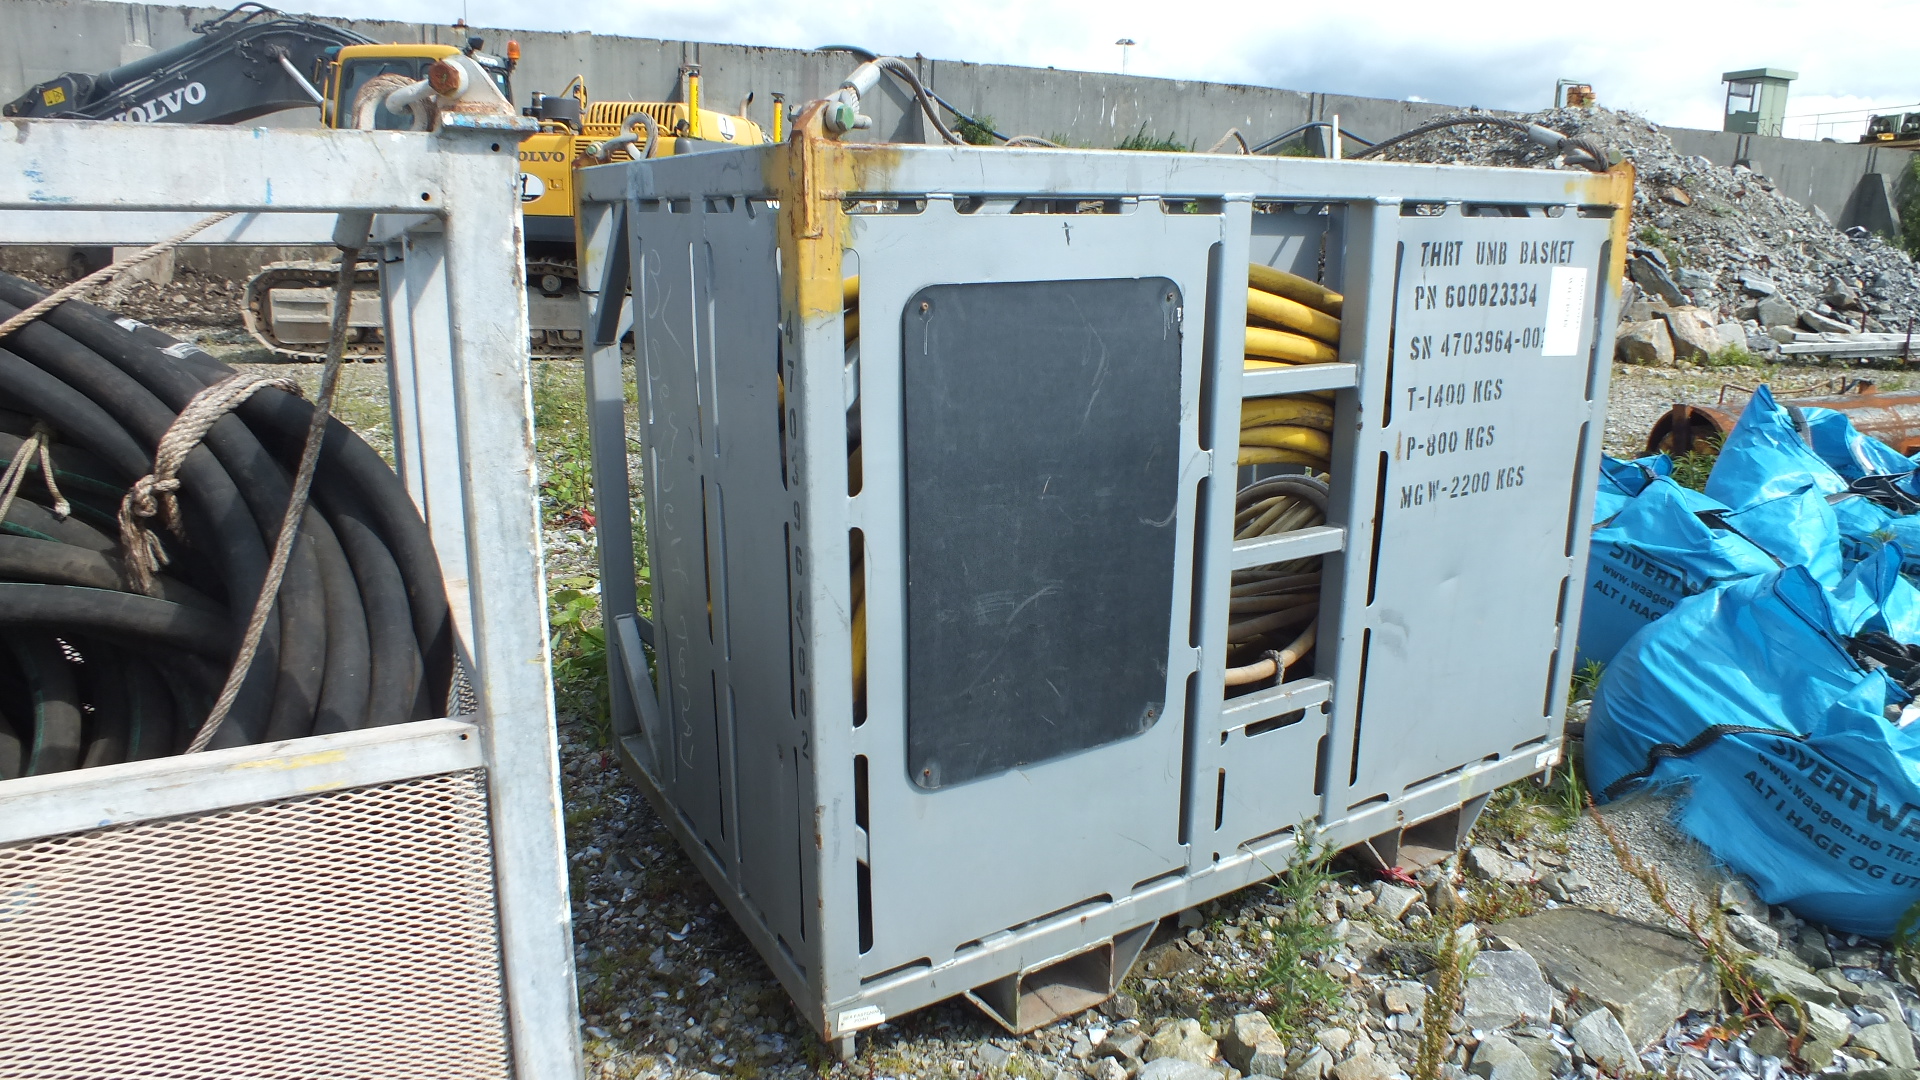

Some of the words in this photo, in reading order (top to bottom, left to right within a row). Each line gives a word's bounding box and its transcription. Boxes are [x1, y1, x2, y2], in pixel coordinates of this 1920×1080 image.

[519, 151, 565, 162] OLVO
[1421, 241, 1463, 267] THRT
[1476, 241, 1507, 266] UMB
[1520, 240, 1574, 265] BASKET
[1415, 285, 1437, 310] PN
[1446, 282, 1537, 309] 600023334
[1410, 335, 1432, 360] SN
[1440, 327, 1545, 357] 4703964-00
[1408, 383, 1465, 411] T-1400
[1473, 378, 1503, 403] KGS
[1406, 431, 1458, 460] P-800
[1465, 424, 1495, 450] KGS
[1496, 465, 1524, 490] KGS
[1602, 564, 1675, 609] www.waagen
[1609, 541, 1712, 598] SIVERTW
[1593, 580, 1619, 599] ALT
[1628, 600, 1662, 622] HAG
[1757, 752, 1882, 852] www.waagen.no
[1770, 739, 1920, 842] SIVERTWA
[1744, 770, 1778, 800] ALT
[1786, 809, 1847, 859] HAGE
[1848, 855, 1888, 880] OG
[1891, 872, 1920, 889] UT
